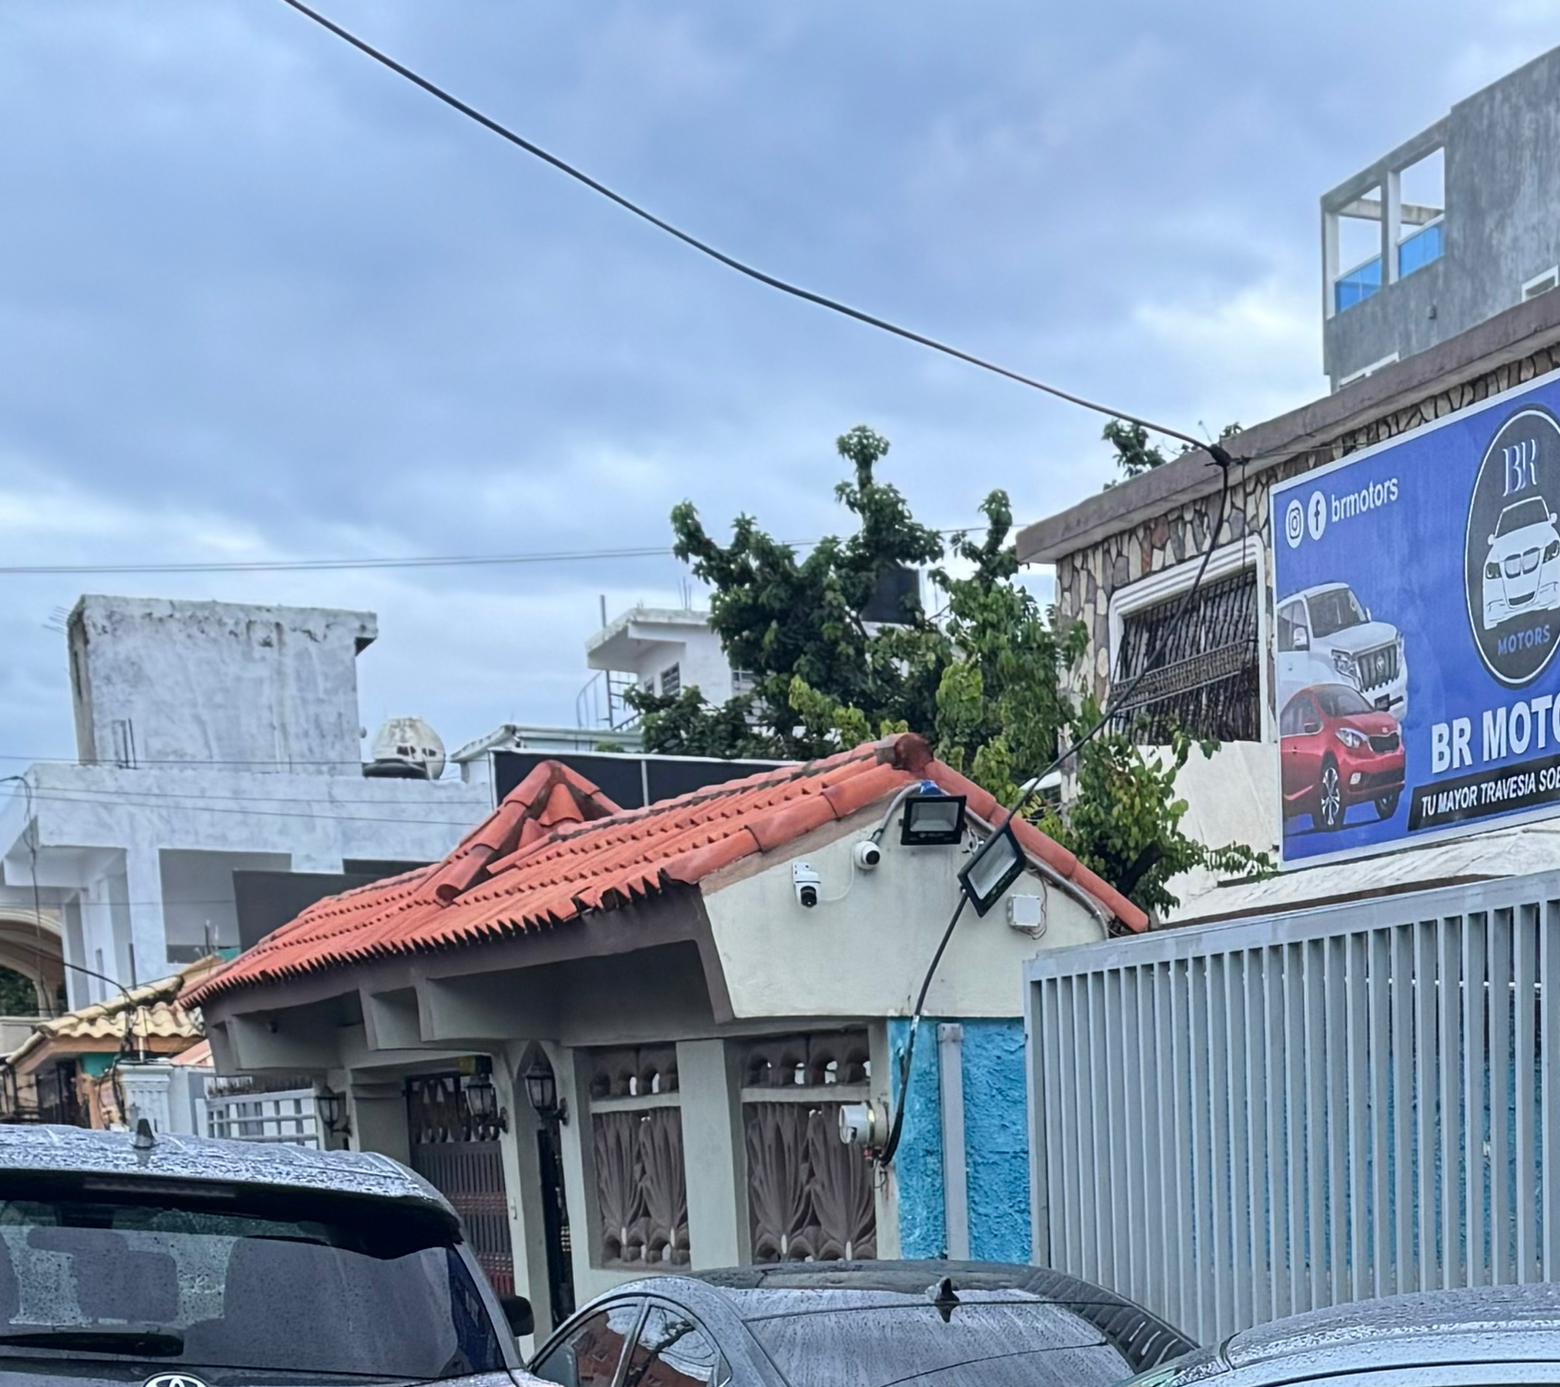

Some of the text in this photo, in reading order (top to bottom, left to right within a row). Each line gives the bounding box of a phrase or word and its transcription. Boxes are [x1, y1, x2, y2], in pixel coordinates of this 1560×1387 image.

[1502, 438, 1537, 497] BR
[1331, 477, 1399, 522] brmotors
[1497, 625, 1551, 656] MOTORS
[1431, 716, 1473, 774] BR
[1421, 796, 1437, 818] TU
[1437, 786, 1477, 813] MAYOR
[1480, 775, 1537, 805] TRAVESIA
